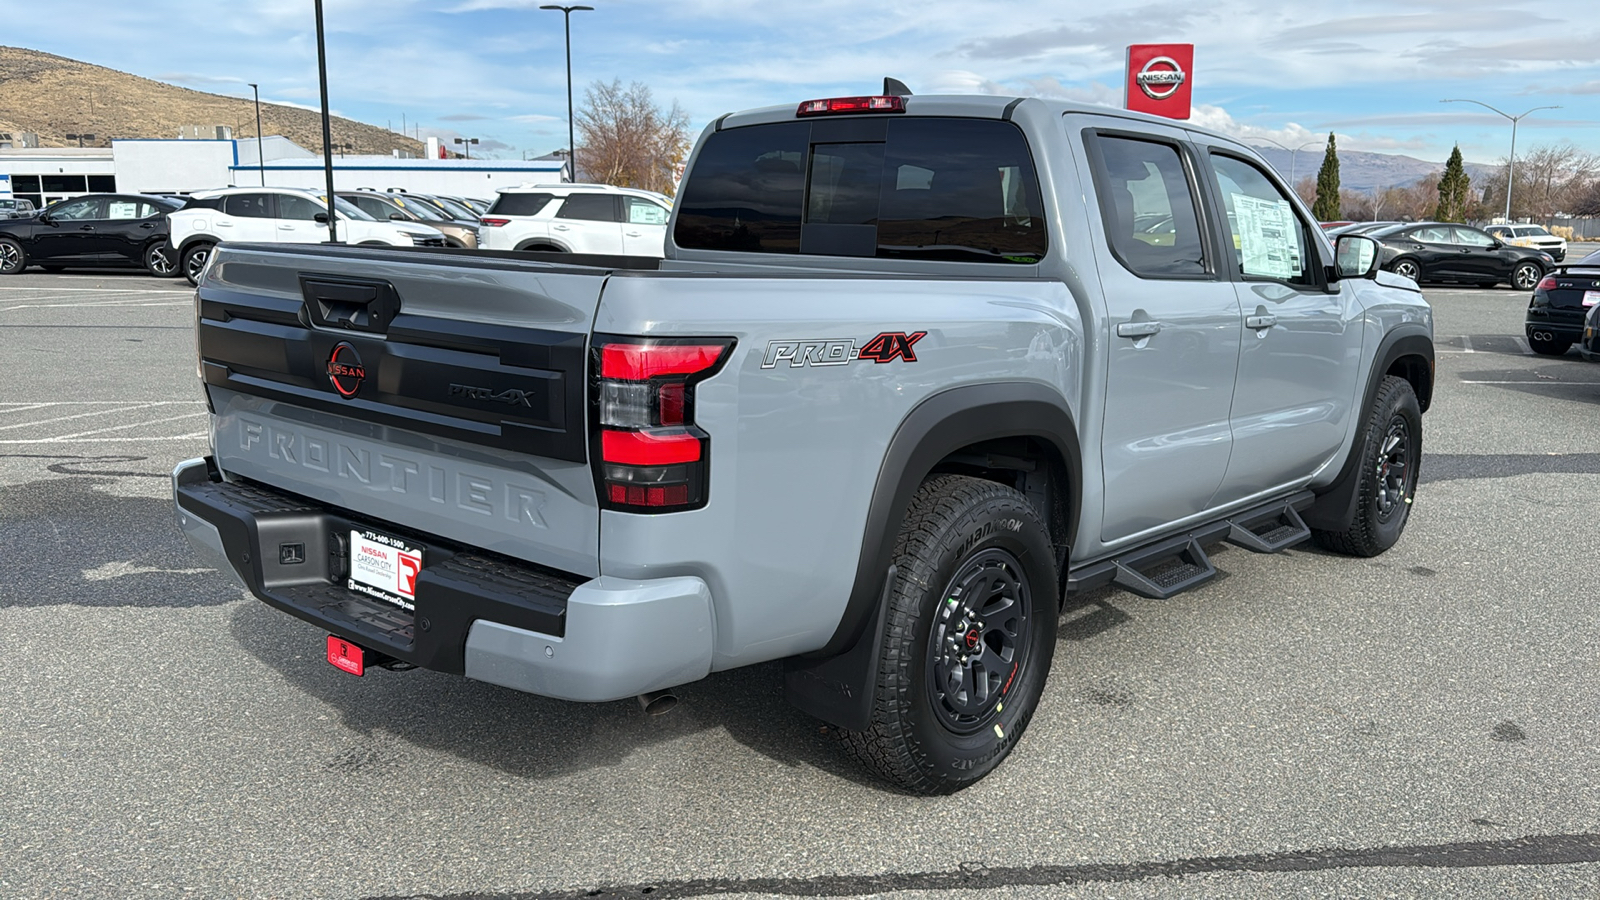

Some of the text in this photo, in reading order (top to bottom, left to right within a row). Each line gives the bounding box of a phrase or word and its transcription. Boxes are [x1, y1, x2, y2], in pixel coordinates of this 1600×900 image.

[1142, 73, 1181, 81] NISSAN
[327, 363, 365, 378] NISSAN
[238, 417, 549, 530] FRONTIER
[361, 545, 387, 560] NISSAN
[357, 553, 392, 571] CARSON CITY
